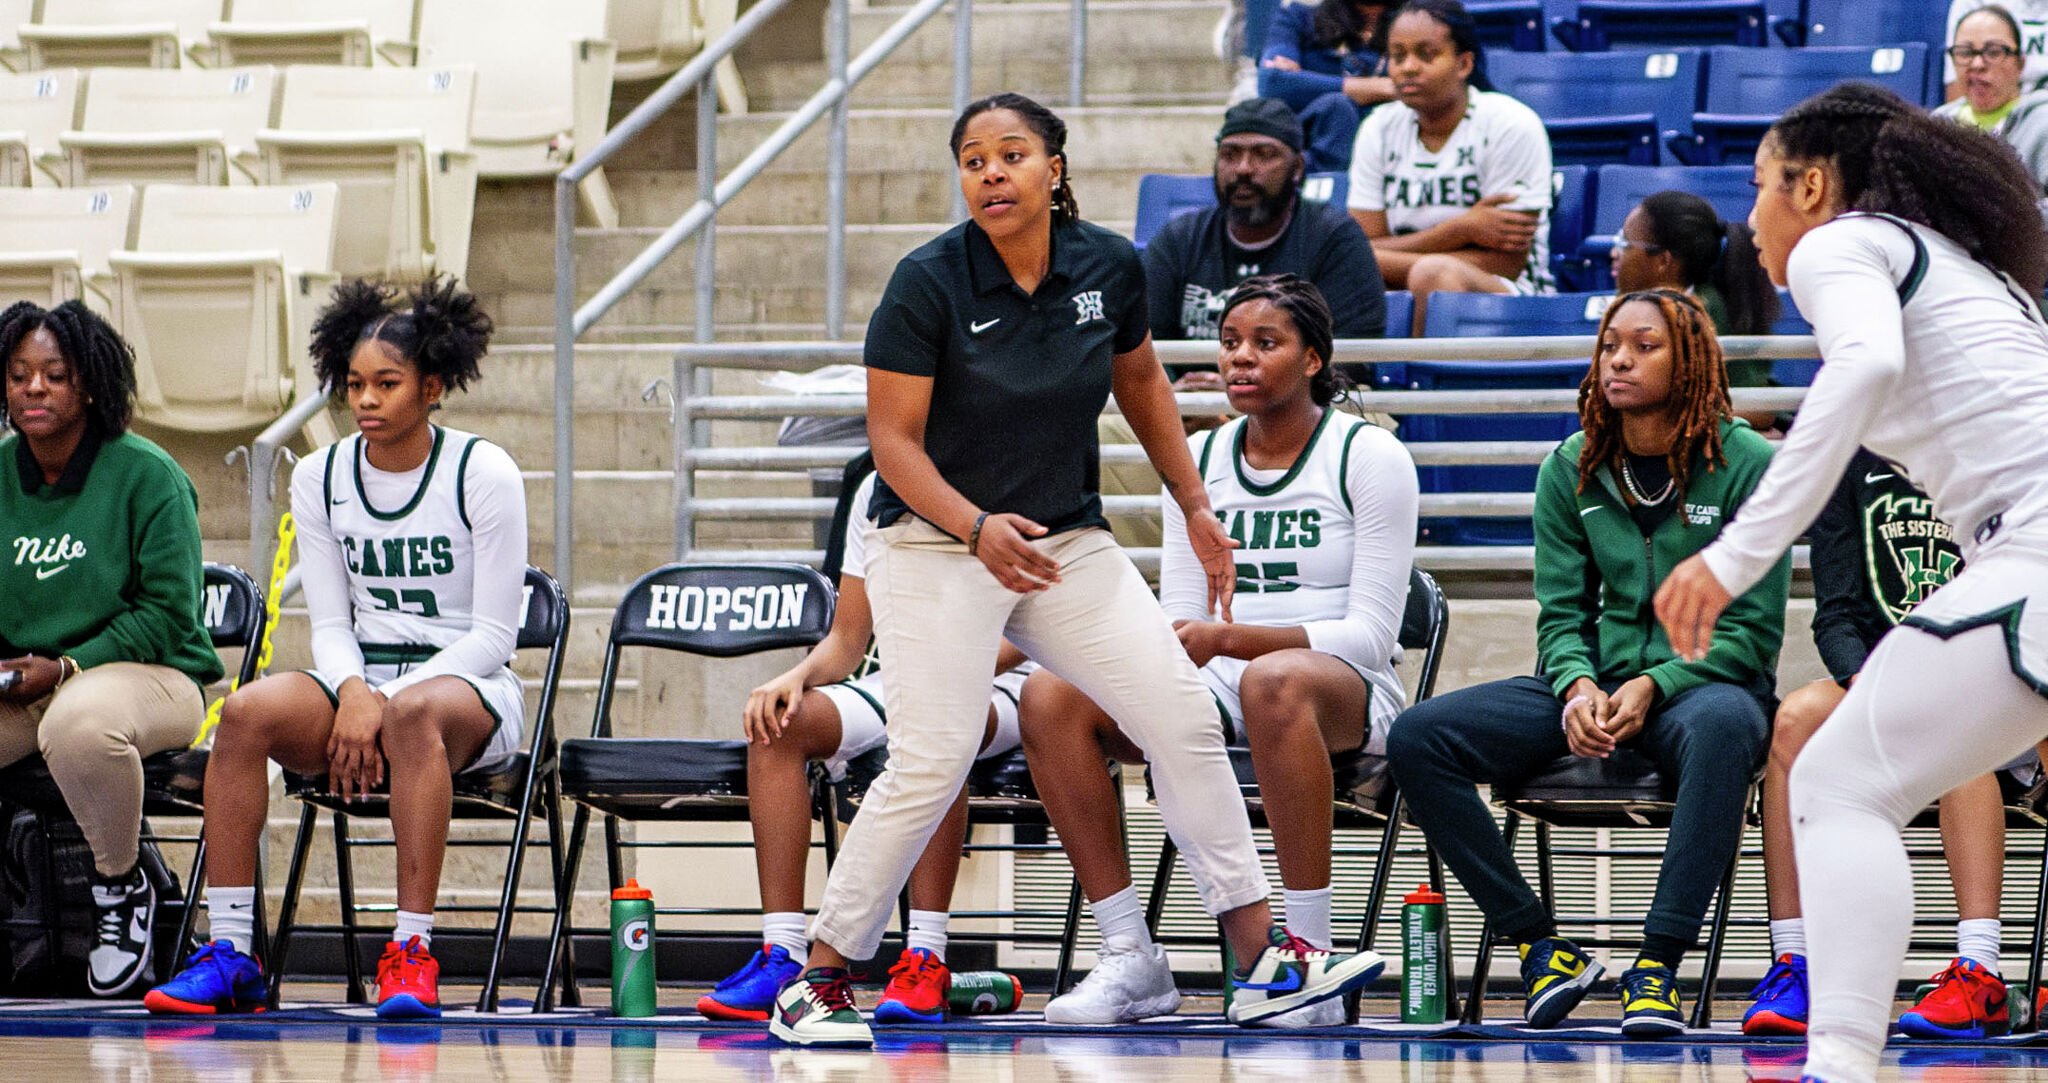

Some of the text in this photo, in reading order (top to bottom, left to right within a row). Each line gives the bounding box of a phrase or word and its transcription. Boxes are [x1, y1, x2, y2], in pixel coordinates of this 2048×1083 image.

[13, 533, 87, 566] Nike
[1878, 521, 1906, 540] THE
[343, 535, 455, 577] CANES
[646, 583, 809, 632] HOPSON
[1409, 911, 1423, 1016] ATHLETIC TRAININ
